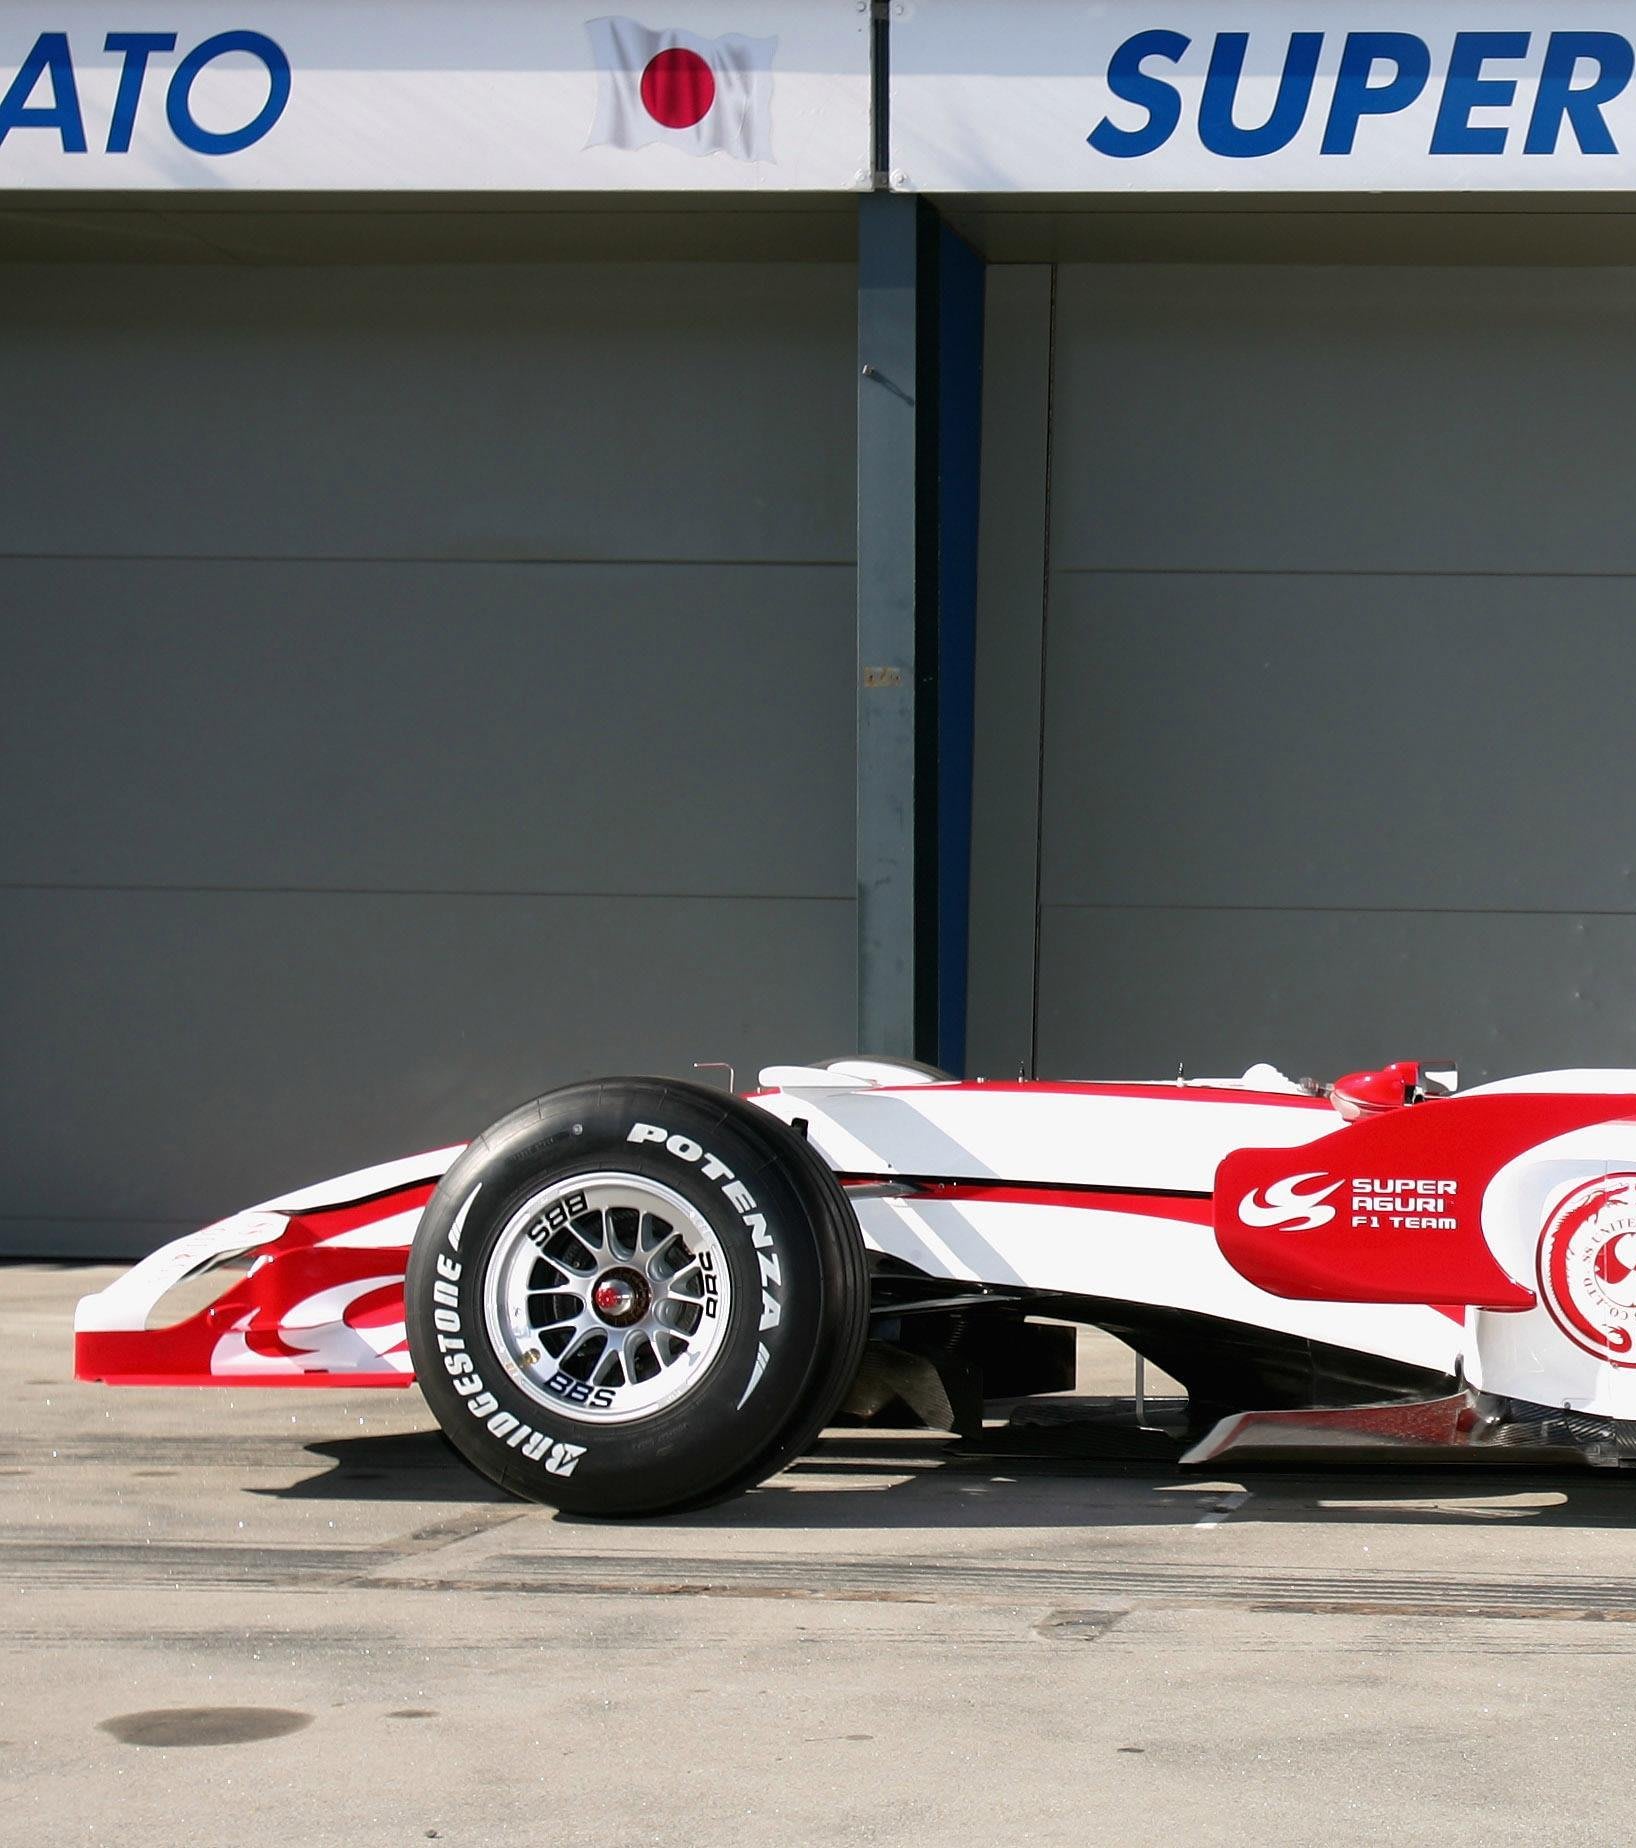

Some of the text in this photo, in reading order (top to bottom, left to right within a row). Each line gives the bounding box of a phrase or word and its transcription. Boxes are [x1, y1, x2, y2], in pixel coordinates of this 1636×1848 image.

[0, 31, 291, 156] ATO
[1086, 29, 1636, 158] SUPER
[1352, 1178, 1457, 1195] SUPER
[1352, 1196, 1444, 1212] AGURI
[527, 1191, 589, 1248] BBS
[626, 1121, 782, 1332] POTENZA
[1352, 1216, 1457, 1229] F1 TEAM
[433, 1253, 588, 1477] BRIDGESTONE
[544, 1371, 617, 1408] BBS
